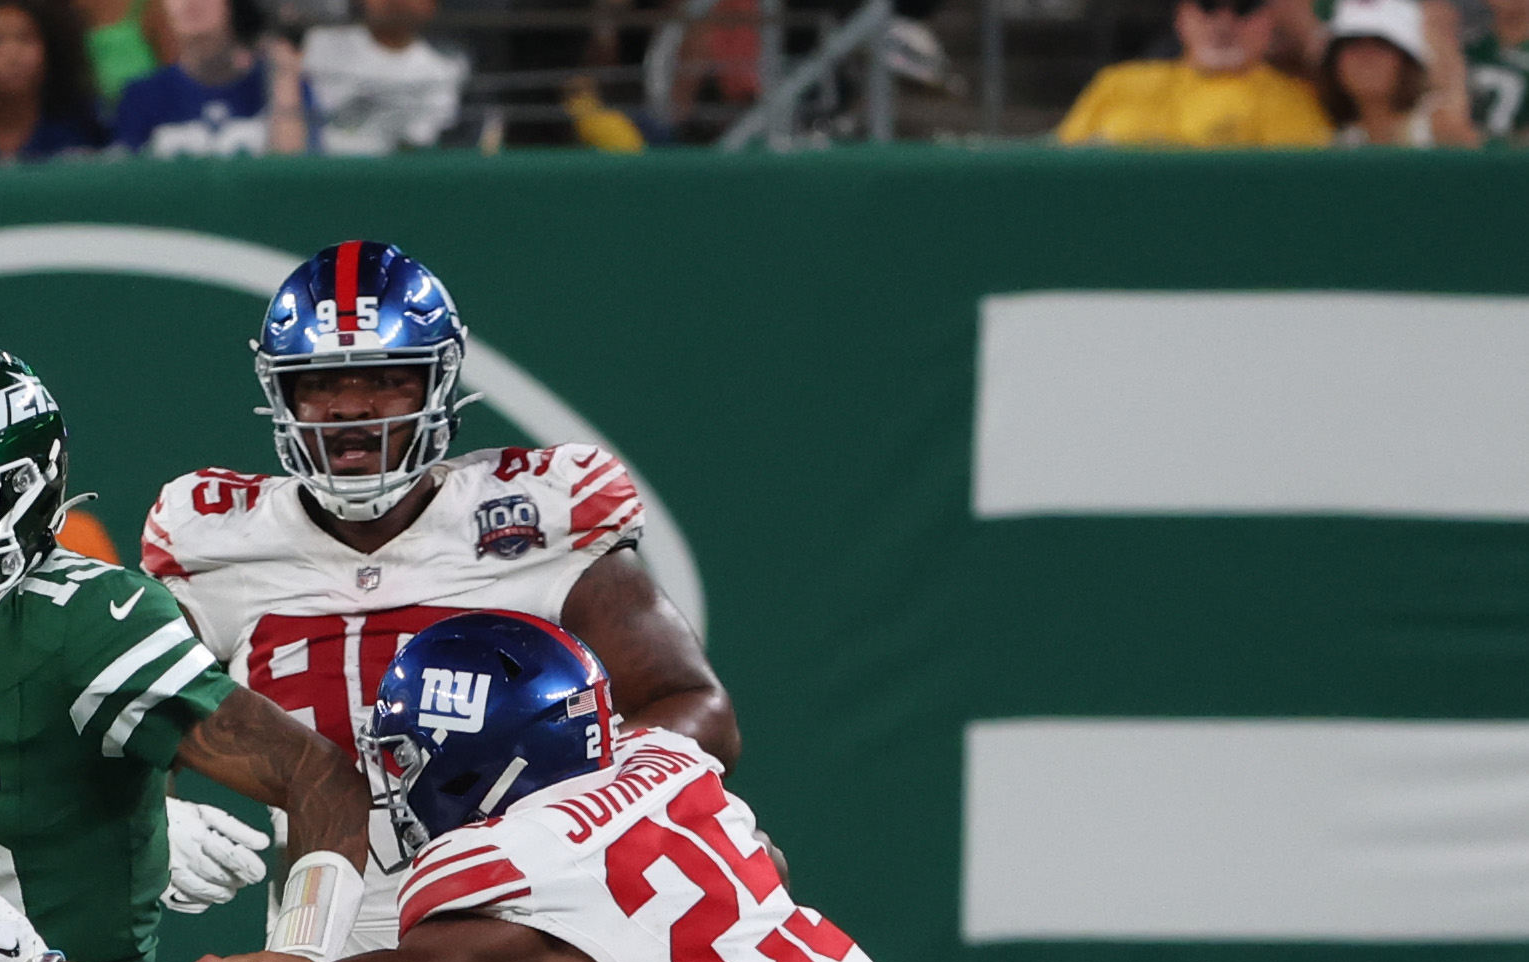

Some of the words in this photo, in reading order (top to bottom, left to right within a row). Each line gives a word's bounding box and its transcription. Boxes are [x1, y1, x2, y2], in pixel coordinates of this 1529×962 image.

[316, 296, 379, 333] 95
[477, 502, 537, 531] 100
[543, 743, 701, 845] JOHNSON
